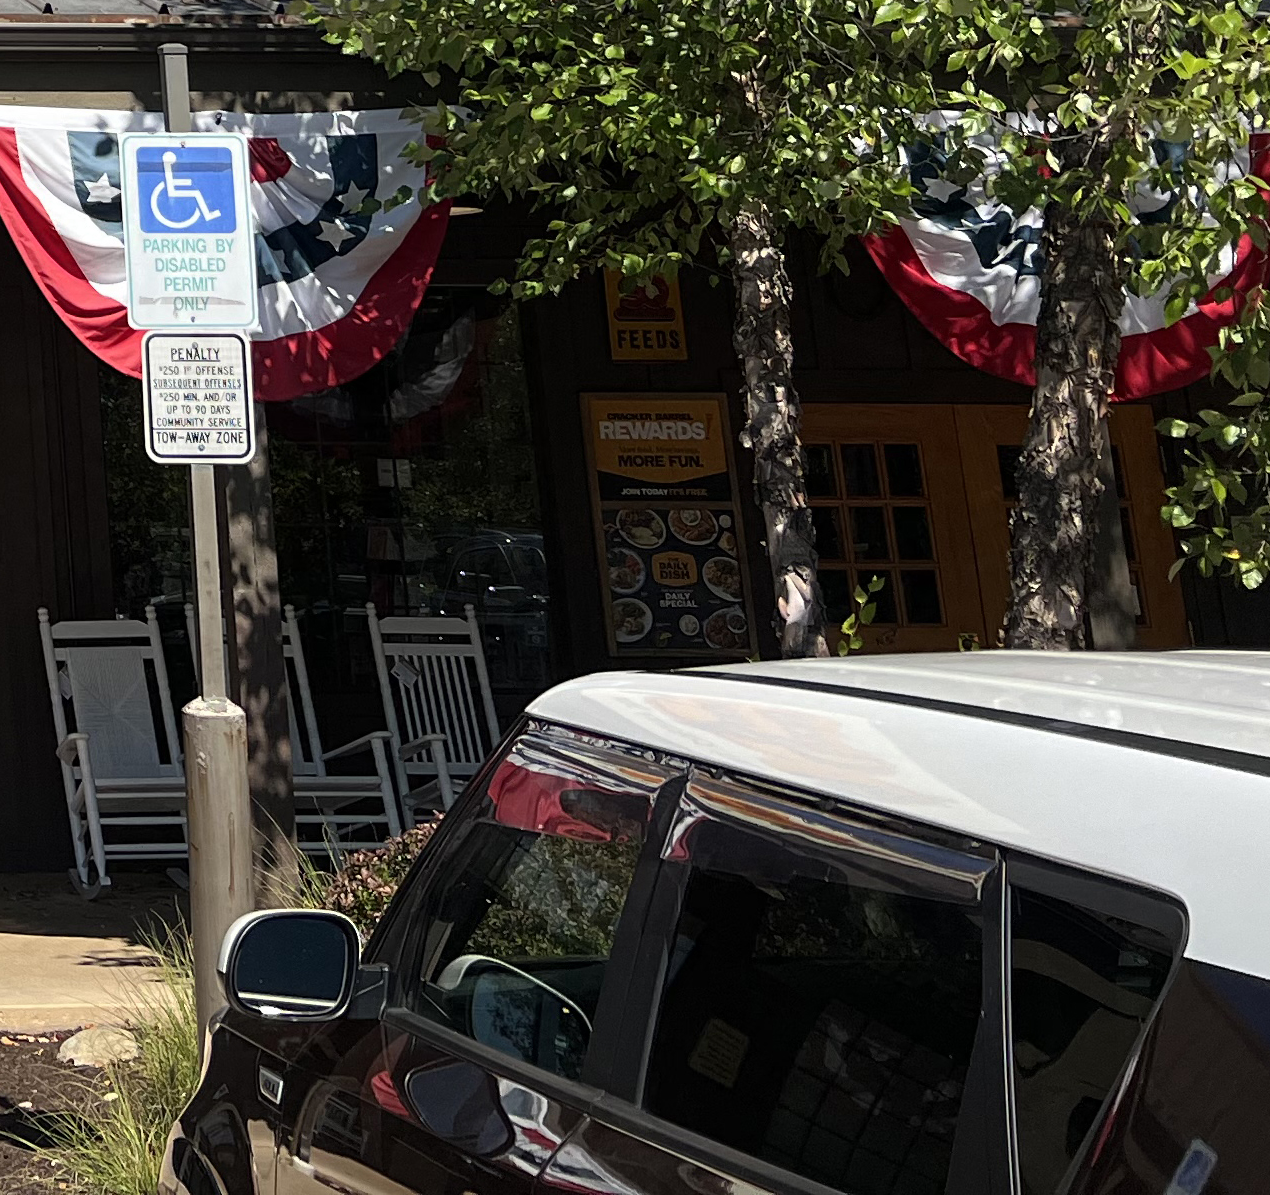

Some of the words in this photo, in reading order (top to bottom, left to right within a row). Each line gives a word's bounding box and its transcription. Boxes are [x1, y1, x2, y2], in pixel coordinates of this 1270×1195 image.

[143, 238, 207, 253] PARKING
[215, 238, 234, 253] BY
[155, 257, 226, 273] DISABLED
[164, 276, 217, 292] PERMIT
[173, 296, 209, 311] ONLY
[617, 330, 680, 349] FEEDS
[171, 347, 220, 361] PENALTY
[196, 366, 235, 375] OFFENSE
[153, 378, 201, 389] SUBSEQUENT
[204, 378, 242, 389] OFFENSES
[204, 392, 237, 402] AND/OR
[166, 405, 178, 414] UP
[181, 405, 192, 414] TO
[195, 405, 207, 415] 90
[210, 405, 231, 415] DAYS
[156, 417, 204, 427] COMMUNITY
[208, 417, 242, 428] SERVICE
[607, 413, 652, 421] CRACKER
[655, 413, 694, 421] BARREL
[156, 431, 211, 444] TOW-AWAY
[216, 431, 245, 444] ZONE
[618, 455, 666, 468] MORE
[668, 455, 704, 468] FUN.
[621, 488, 640, 496] JOIN
[641, 488, 668, 496] TODAY
[659, 562, 689, 570] DAILY
[660, 571, 690, 580] DISH
[664, 592, 691, 600] DAILY
[659, 599, 699, 608] SPECIAL
